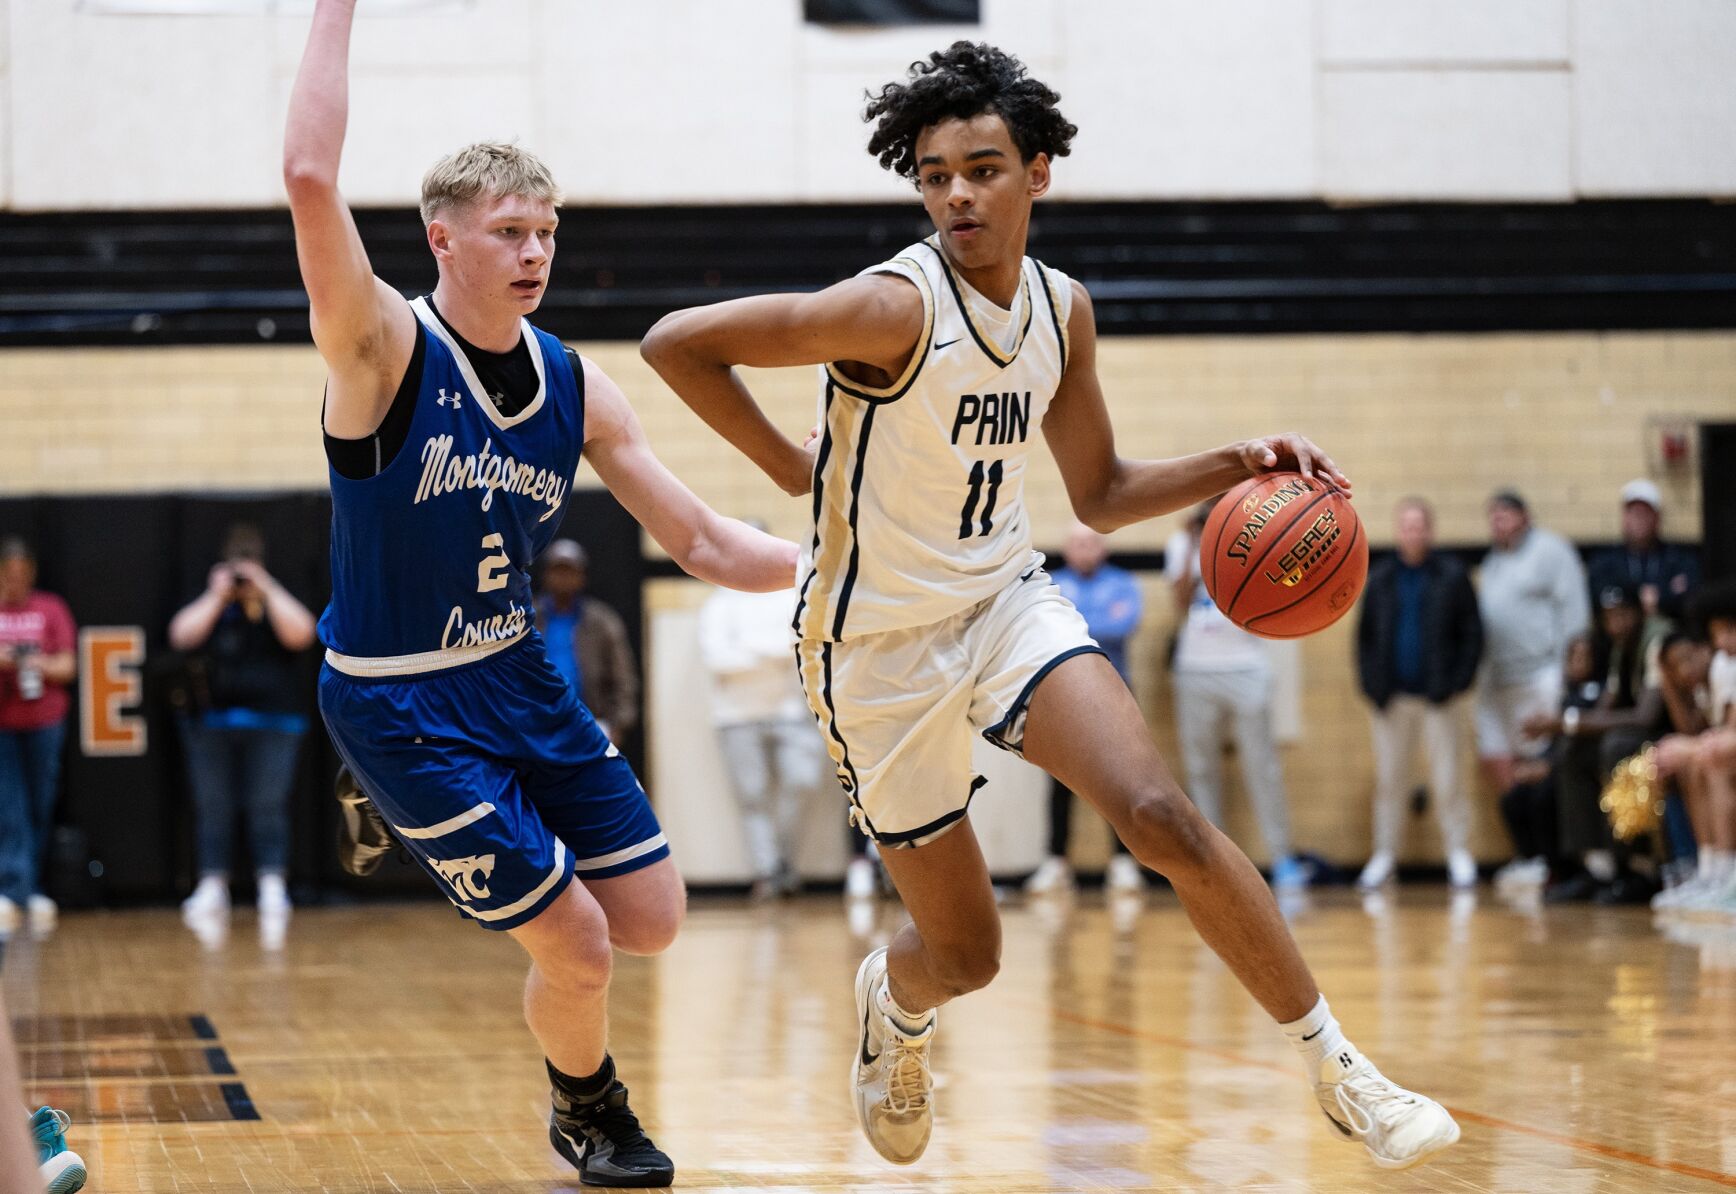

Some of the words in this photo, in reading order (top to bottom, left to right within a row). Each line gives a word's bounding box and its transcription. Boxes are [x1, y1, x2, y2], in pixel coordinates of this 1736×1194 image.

[951, 391, 1031, 445] PRIN
[414, 434, 567, 523] Montgomery
[958, 459, 1003, 540] 11
[1227, 479, 1314, 567] SPALDING
[1265, 508, 1337, 584] LEGACY
[477, 532, 511, 593] 2
[441, 600, 526, 649] County
[79, 625, 148, 757] E
